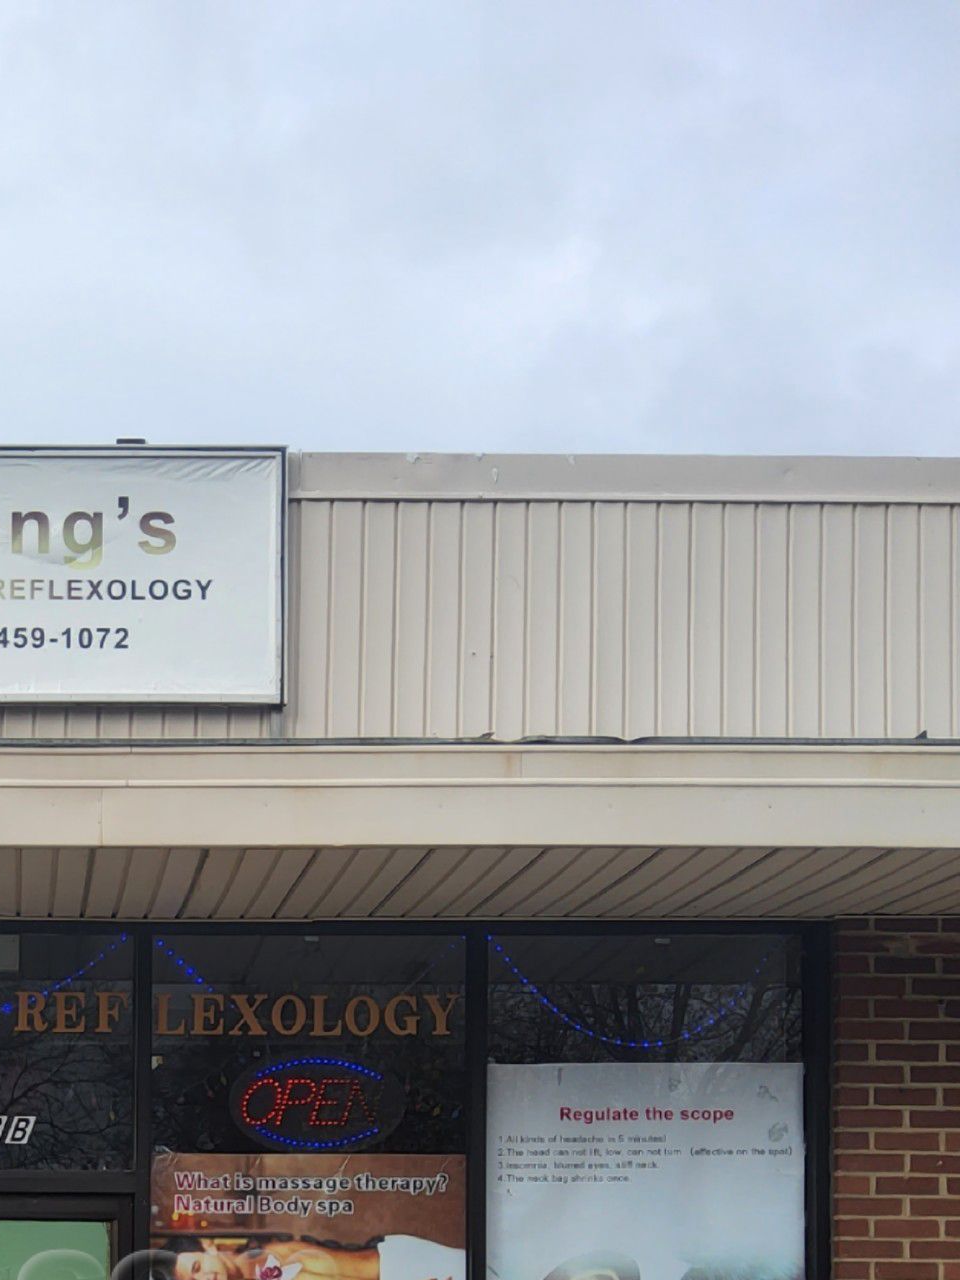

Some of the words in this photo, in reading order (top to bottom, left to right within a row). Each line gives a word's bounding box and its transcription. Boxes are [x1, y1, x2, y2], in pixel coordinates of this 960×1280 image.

[241, 1078, 384, 1127] OPEN
[559, 1106, 639, 1124] Regulate
[645, 1107, 674, 1121] the
[680, 1109, 735, 1124] scope
[548, 1135, 557, 1143] of
[553, 1148, 569, 1157] can
[572, 1148, 586, 1157] not
[627, 1148, 643, 1157] can
[646, 1148, 661, 1157] not
[736, 1148, 748, 1157] on
[751, 1148, 766, 1157] the
[175, 1172, 229, 1190] What
[235, 1173, 253, 1190] is
[257, 1176, 351, 1193] massage
[355, 1173, 449, 1195] therapy?
[174, 1195, 253, 1213] Natural
[258, 1196, 311, 1216] Body
[316, 1200, 353, 1217] spa
